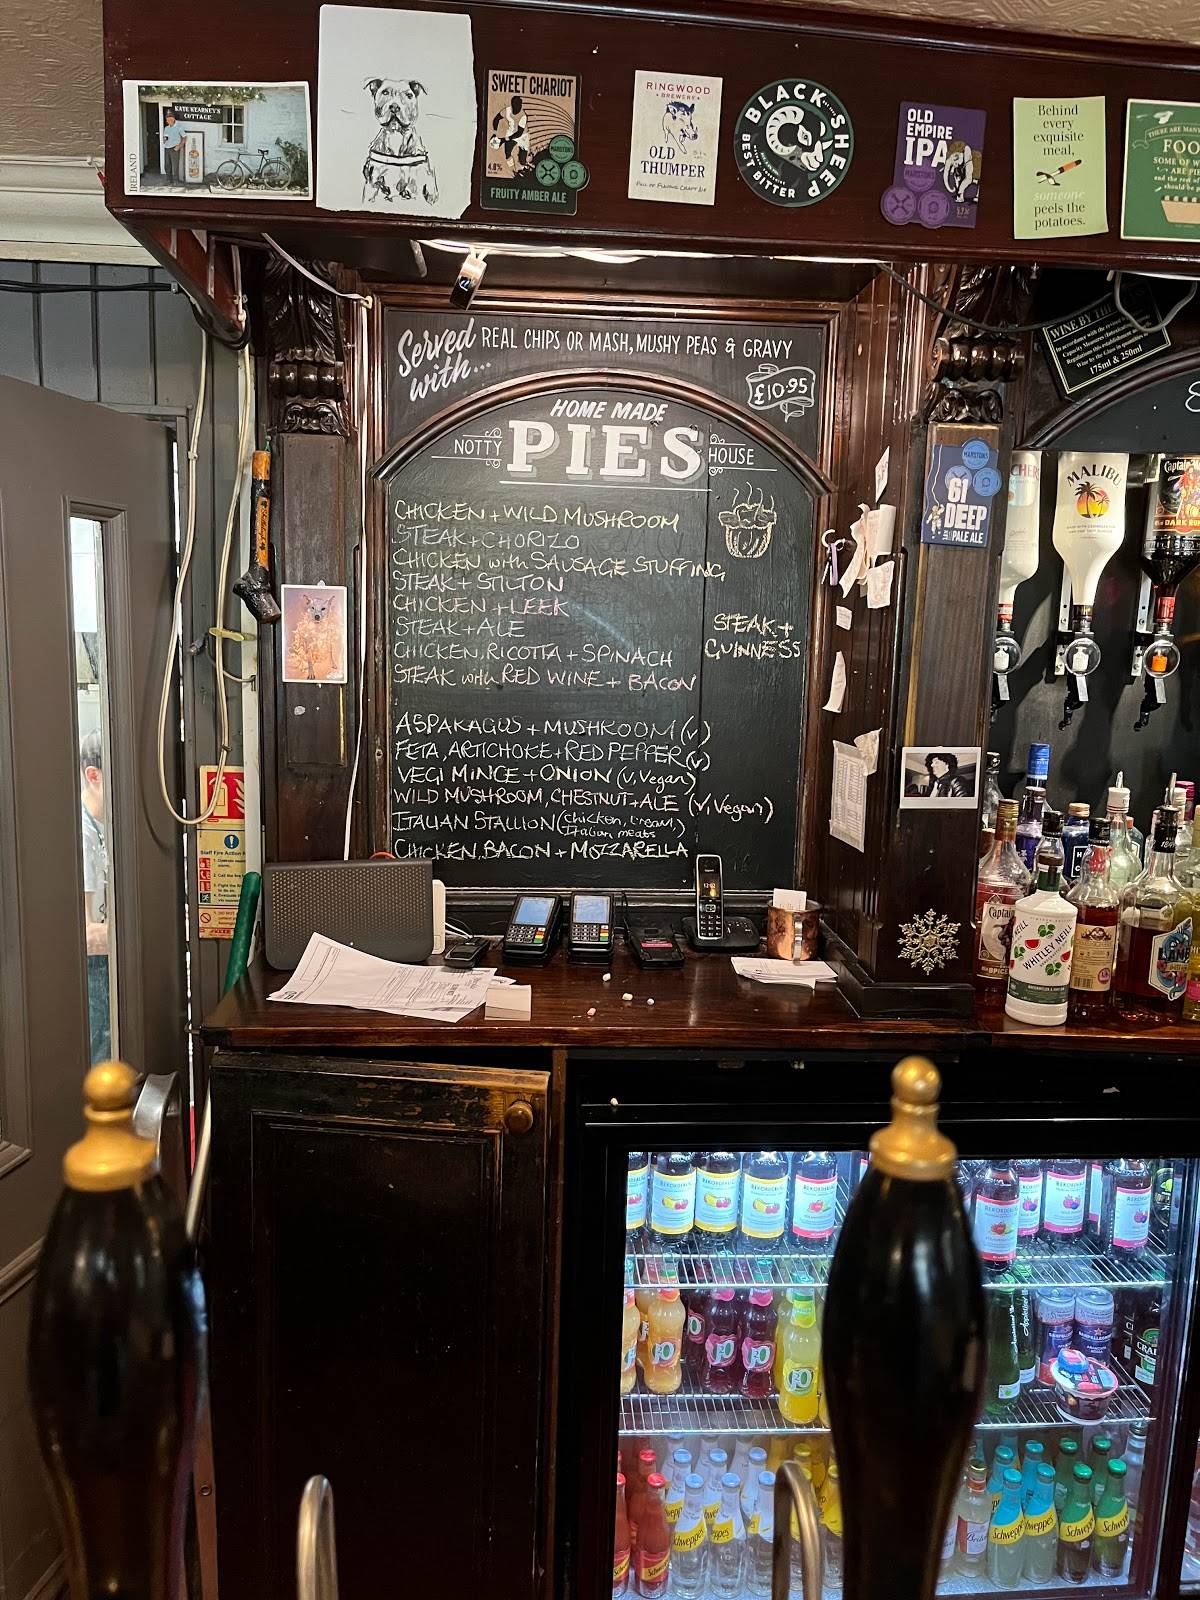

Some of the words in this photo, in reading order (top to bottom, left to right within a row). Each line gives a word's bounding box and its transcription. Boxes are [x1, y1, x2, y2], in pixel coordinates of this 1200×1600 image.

[491, 73, 527, 94] SWEET
[529, 75, 573, 97] CHARIOT
[646, 82, 711, 95] RINGWOOD
[744, 83, 828, 124] BLACK
[907, 108, 934, 123] OLD
[1038, 105, 1078, 116] Behind
[906, 123, 953, 140] EMPIRE
[1043, 119, 1074, 130] every
[1033, 131, 1084, 144] exquisite
[649, 145, 675, 160] OLD
[741, 133, 756, 169] BEST
[808, 114, 850, 198] SHEEP
[903, 136, 947, 168] IPA
[1043, 145, 1075, 157] meal,
[129, 153, 138, 193] IRELAND
[640, 160, 705, 178] THUMPER
[752, 166, 796, 199] BITTER
[490, 187, 519, 200] FRUITY
[521, 189, 550, 202] AMBER
[551, 191, 567, 203] ALE
[1033, 190, 1085, 201] someone
[1034, 203, 1063, 217] peels
[1067, 202, 1085, 213] the
[1034, 216, 1086, 231] potatoes.
[1050, 320, 1078, 339] WINE
[1079, 311, 1093, 327] BY
[397, 317, 477, 378] Served
[481, 327, 518, 349] REAL
[523, 329, 561, 351] CHIPS
[566, 331, 584, 351] OR
[588, 331, 634, 356] MASH,
[636, 333, 680, 356] MUSHY
[686, 334, 717, 356] PEAS
[724, 337, 736, 359] &
[743, 338, 793, 360] GRAVY
[1089, 359, 1112, 375] 175ml
[1112, 355, 1120, 365] &
[1119, 344, 1143, 360] 250ml
[549, 398, 607, 419] HOME
[610, 401, 669, 422] MADE
[453, 437, 502, 456] NOTTY
[507, 419, 706, 482] PIES
[708, 446, 755, 465] HOUSE
[1066, 463, 1122, 489] MALIBU
[947, 477, 969, 503] 61
[394, 499, 485, 522] CHICKEN
[503, 504, 558, 523] WILD
[564, 506, 680, 533] MUSHROOM
[943, 502, 988, 530] DEEP
[396, 523, 467, 547] STEAK
[951, 530, 970, 543] PALE
[970, 531, 984, 544] ALE
[392, 547, 481, 570] CHICKEN
[489, 552, 529, 570] with
[530, 551, 629, 578] SAUSAGE
[632, 555, 726, 582] STUFFING
[392, 569, 456, 592] STEAK
[476, 571, 564, 593] STILTON
[392, 593, 486, 615] CHICKEN
[510, 595, 570, 618] LEEK
[395, 615, 461, 637] STEAK
[476, 617, 526, 637] ALE
[714, 612, 777, 638] STEAK
[486, 641, 562, 662] RICOTTA
[580, 643, 673, 668] SPINACH
[704, 637, 802, 660] GUINNESS
[393, 663, 456, 686] STEAK
[460, 668, 500, 686] with
[500, 662, 542, 686] RED
[547, 669, 605, 688] WINE
[628, 670, 697, 692] BACON
[448, 739, 553, 760] ARTICHOKE
[564, 739, 605, 762] RED
[608, 741, 687, 768] PEPPER
[397, 765, 445, 786] VEGI
[451, 763, 521, 784] MINCE
[539, 763, 613, 783] ONION
[393, 787, 439, 805] WILD
[550, 787, 634, 808] CHESTNUT
[639, 793, 680, 812] ALE
[391, 810, 469, 832] ITALIAN
[473, 810, 556, 832] STALLION
[483, 839, 551, 860] BACON
[570, 841, 689, 861] MOZZARELLA
[1023, 942, 1056, 971] WHITLEY
[1055, 924, 1073, 945] NEILL
